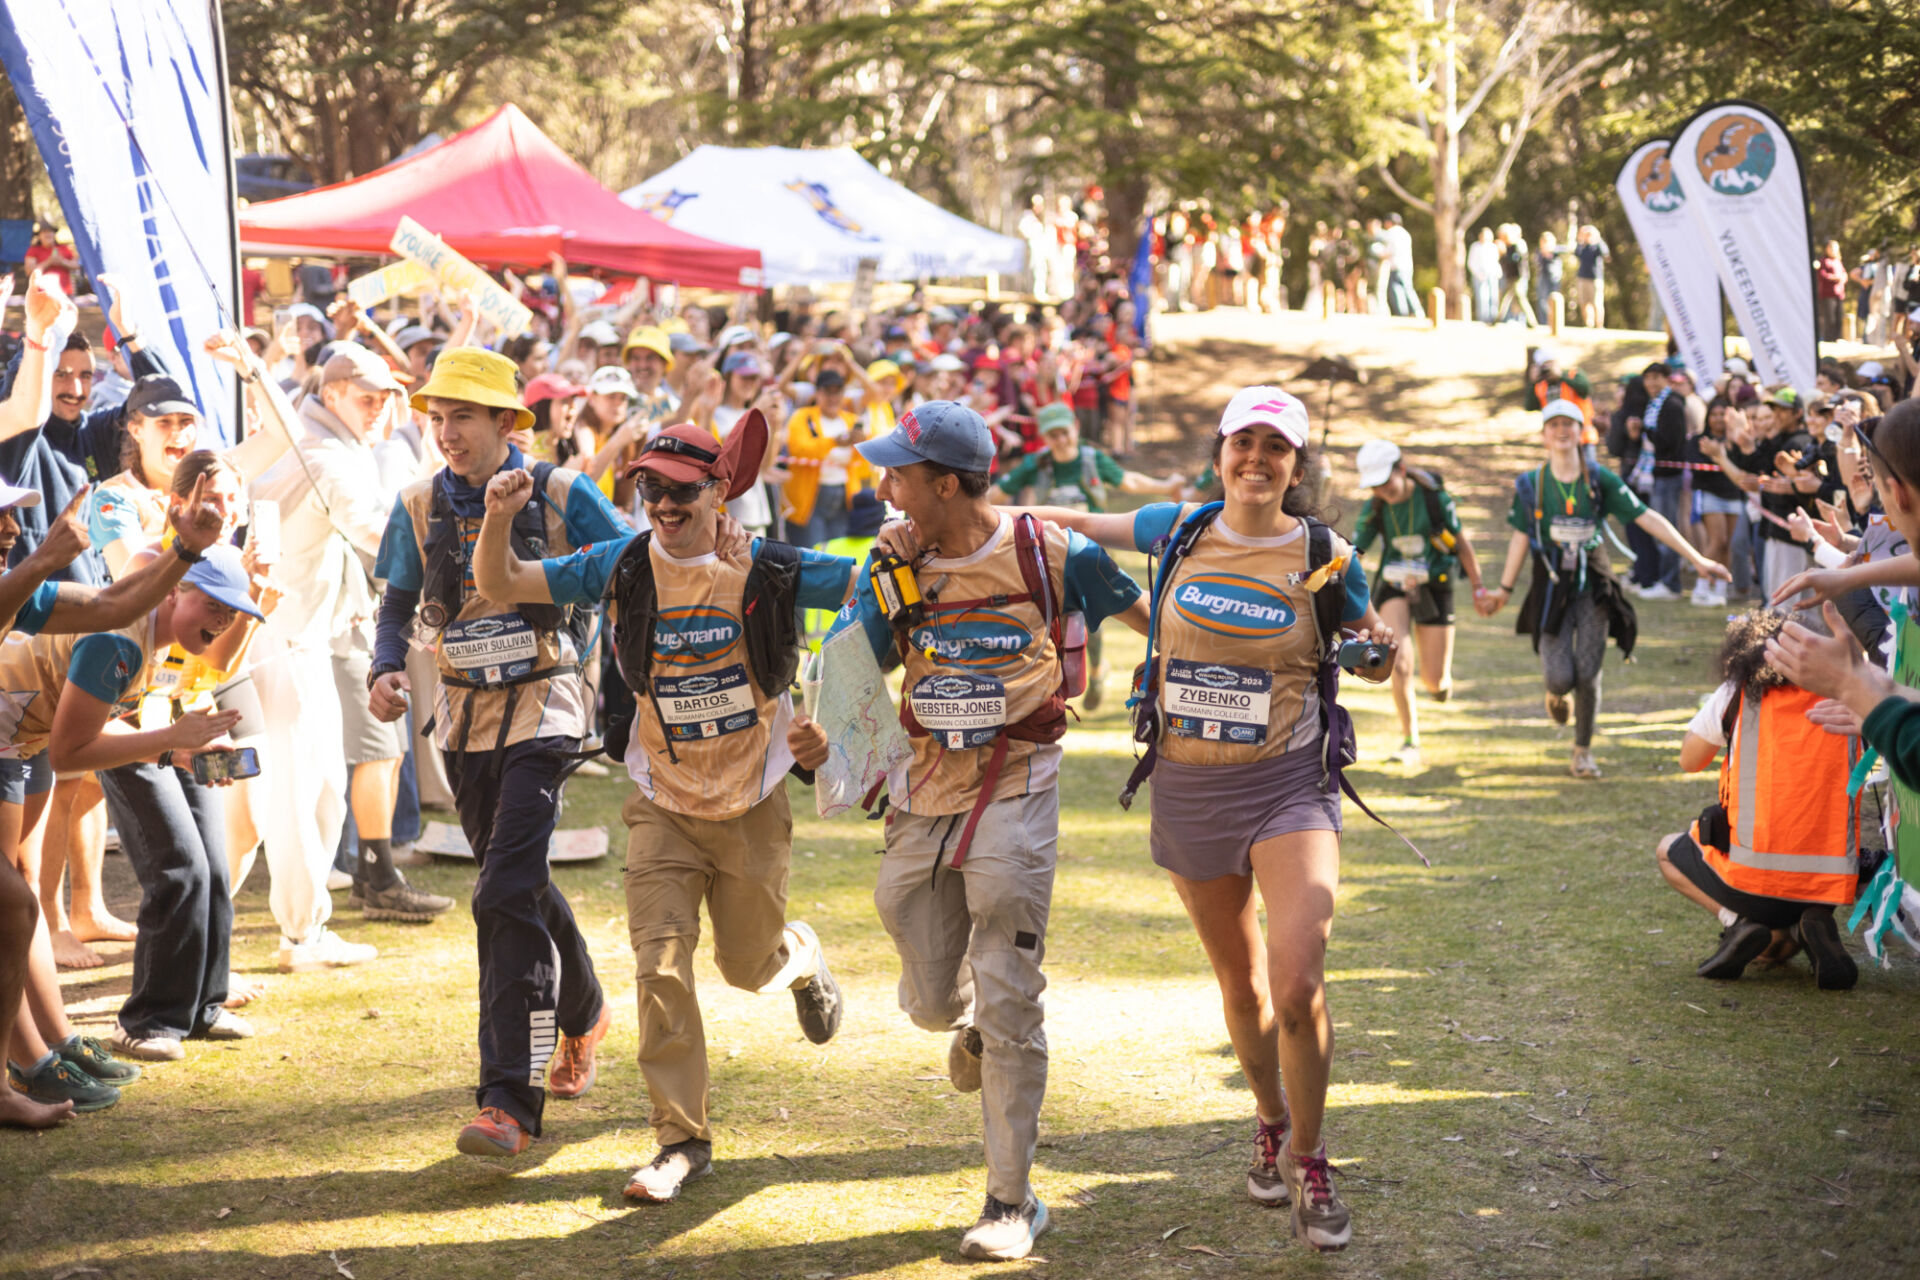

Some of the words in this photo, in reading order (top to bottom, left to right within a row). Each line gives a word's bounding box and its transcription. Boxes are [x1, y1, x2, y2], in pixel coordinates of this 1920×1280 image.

[1720, 228, 1781, 360] YUKEEMBRUK
[1180, 585, 1287, 623] Burgmann
[445, 642, 489, 657] SZATMARY
[490, 634, 533, 650] SULLIVAN
[654, 625, 733, 650] urgmann
[720, 673, 740, 685] 2024
[975, 683, 996, 692] 2024
[1241, 677, 1263, 686] 2024
[673, 693, 730, 711] BARTOS
[1179, 687, 1251, 707] ZYBENKO
[913, 700, 1002, 714] WEBSTER-JONES
[1171, 703, 1213, 716] BURGMANN
[667, 713, 705, 722] BURGMANN
[528, 1010, 556, 1087] PUMA
